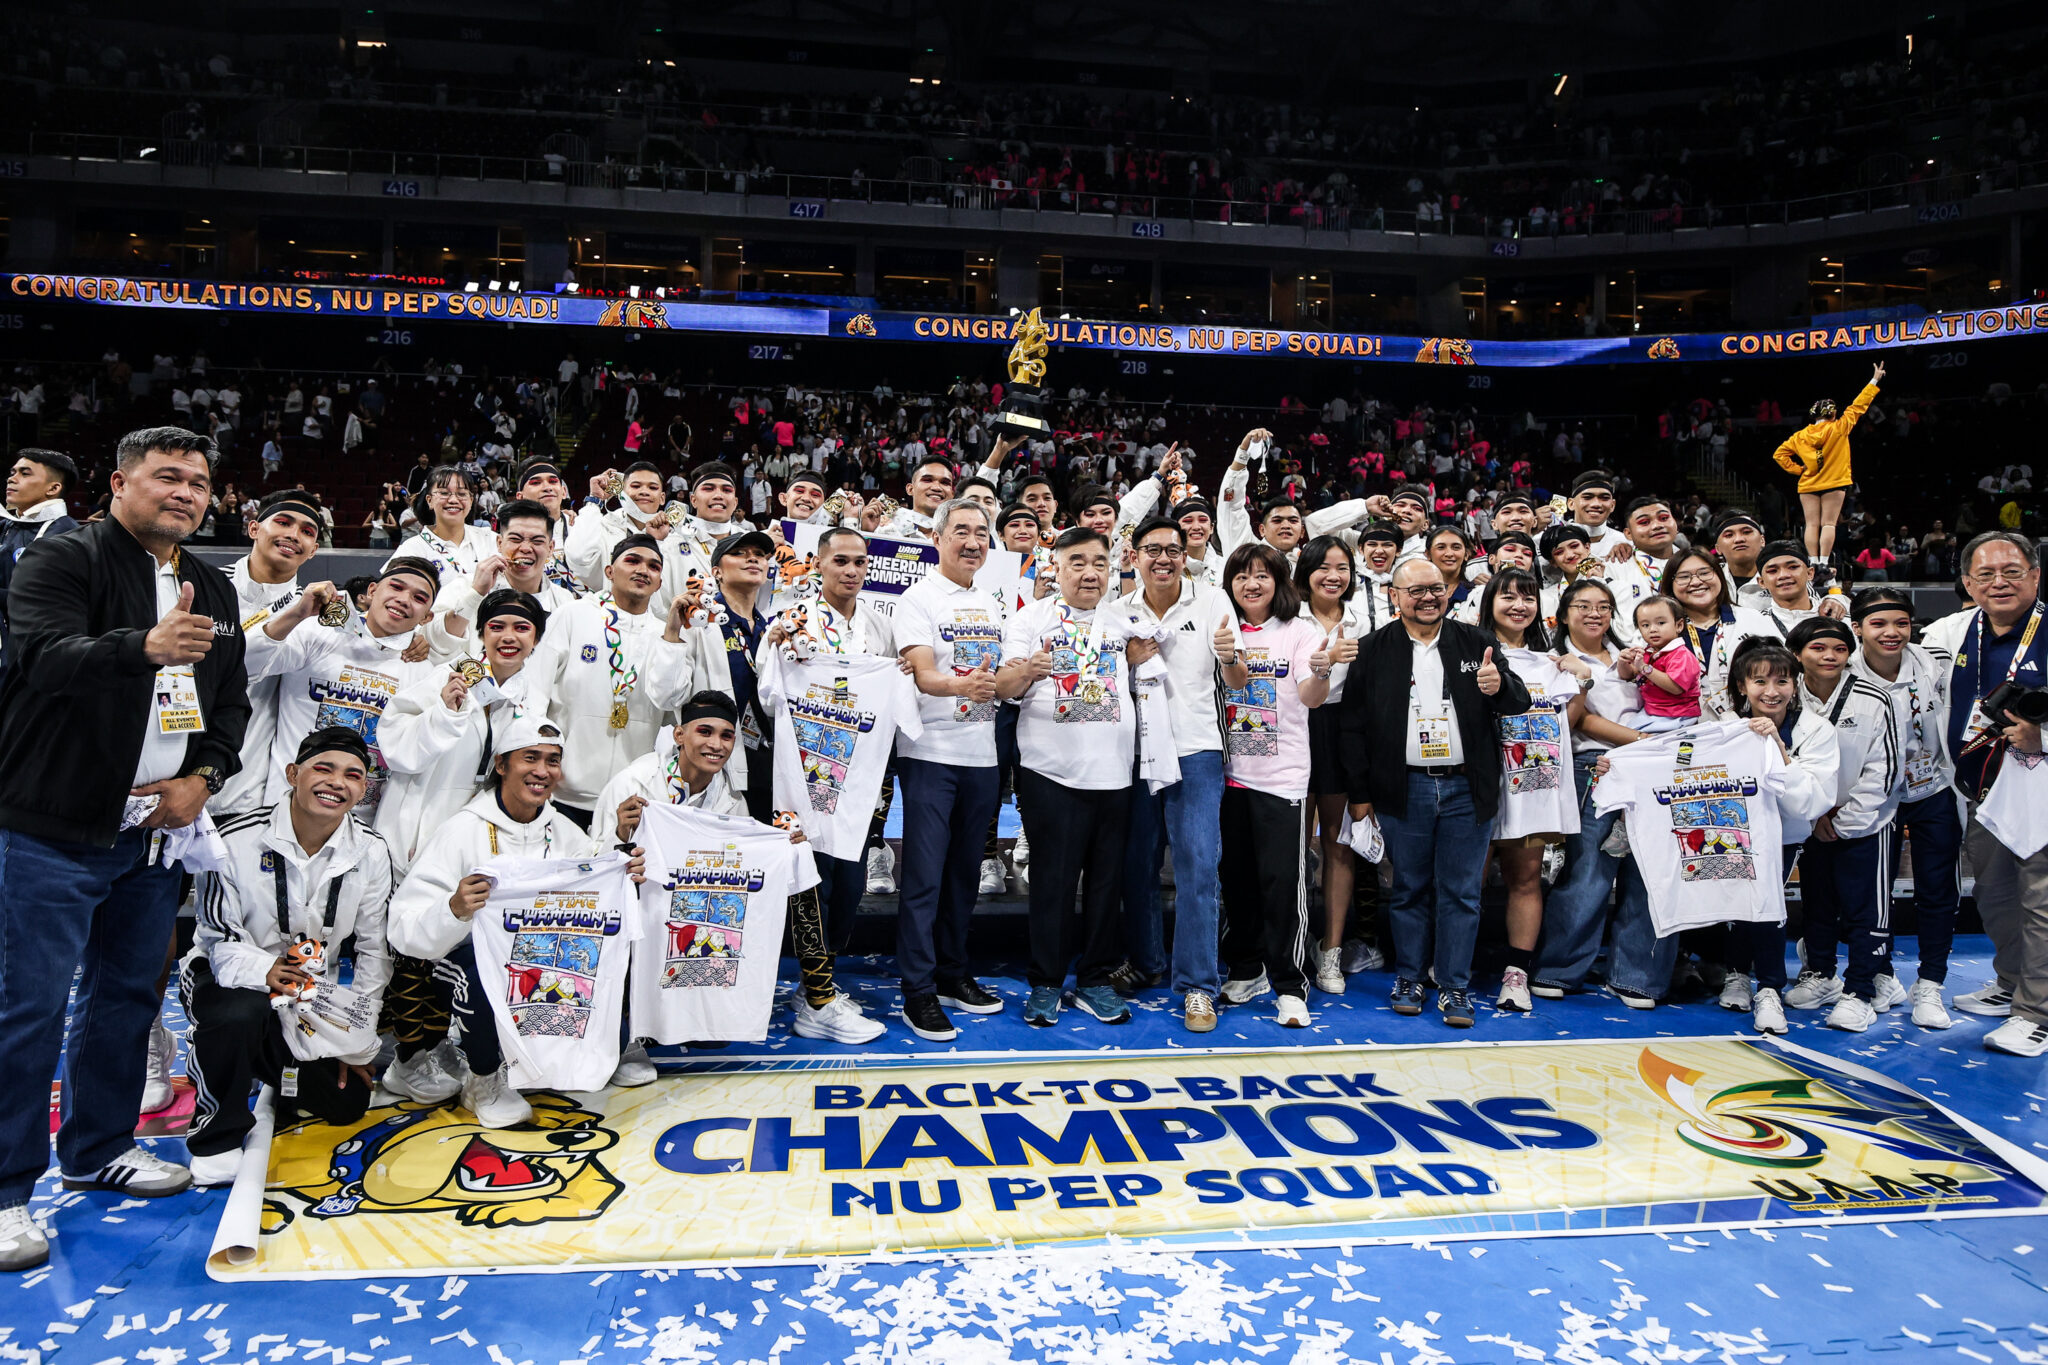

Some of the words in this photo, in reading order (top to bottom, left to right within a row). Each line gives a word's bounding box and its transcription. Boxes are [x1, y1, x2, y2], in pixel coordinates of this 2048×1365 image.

[386, 182, 416, 196] 416
[793, 203, 821, 217] 417
[1918, 205, 1961, 222] 420A
[1135, 223, 1161, 237] 418
[1493, 243, 1518, 256] 419
[11, 275, 321, 311] CONGRATULATIONS,
[331, 289, 373, 312] NU
[383, 291, 439, 314] PEP
[448, 294, 559, 320] SQUAD!
[383, 330, 411, 346] 216
[914, 317, 1180, 350] CONGRAULATIONS,
[1188, 329, 1224, 349] NU
[1233, 331, 1281, 352] PEP
[1288, 333, 1382, 356] SQUAD!
[753, 345, 779, 360] 217
[1929, 352, 1968, 369] 220
[1122, 360, 1147, 375] 218
[1467, 374, 1491, 389] 219
[898, 545, 922, 555] UAAP
[175, 693, 181, 701] C
[185, 692, 195, 701] AD
[1653, 776, 1758, 805] CHAMPIONS
[503, 908, 621, 936] CHAMPIONS
[813, 1073, 1401, 1110] BACK-TO-BACK
[655, 1097, 1601, 1175] CHAMPIONS
[831, 1179, 966, 1218] NU
[989, 1172, 1163, 1211] PEP
[1184, 1163, 1501, 1207] SQUAD
[1750, 1172, 1964, 1204] UAAP
